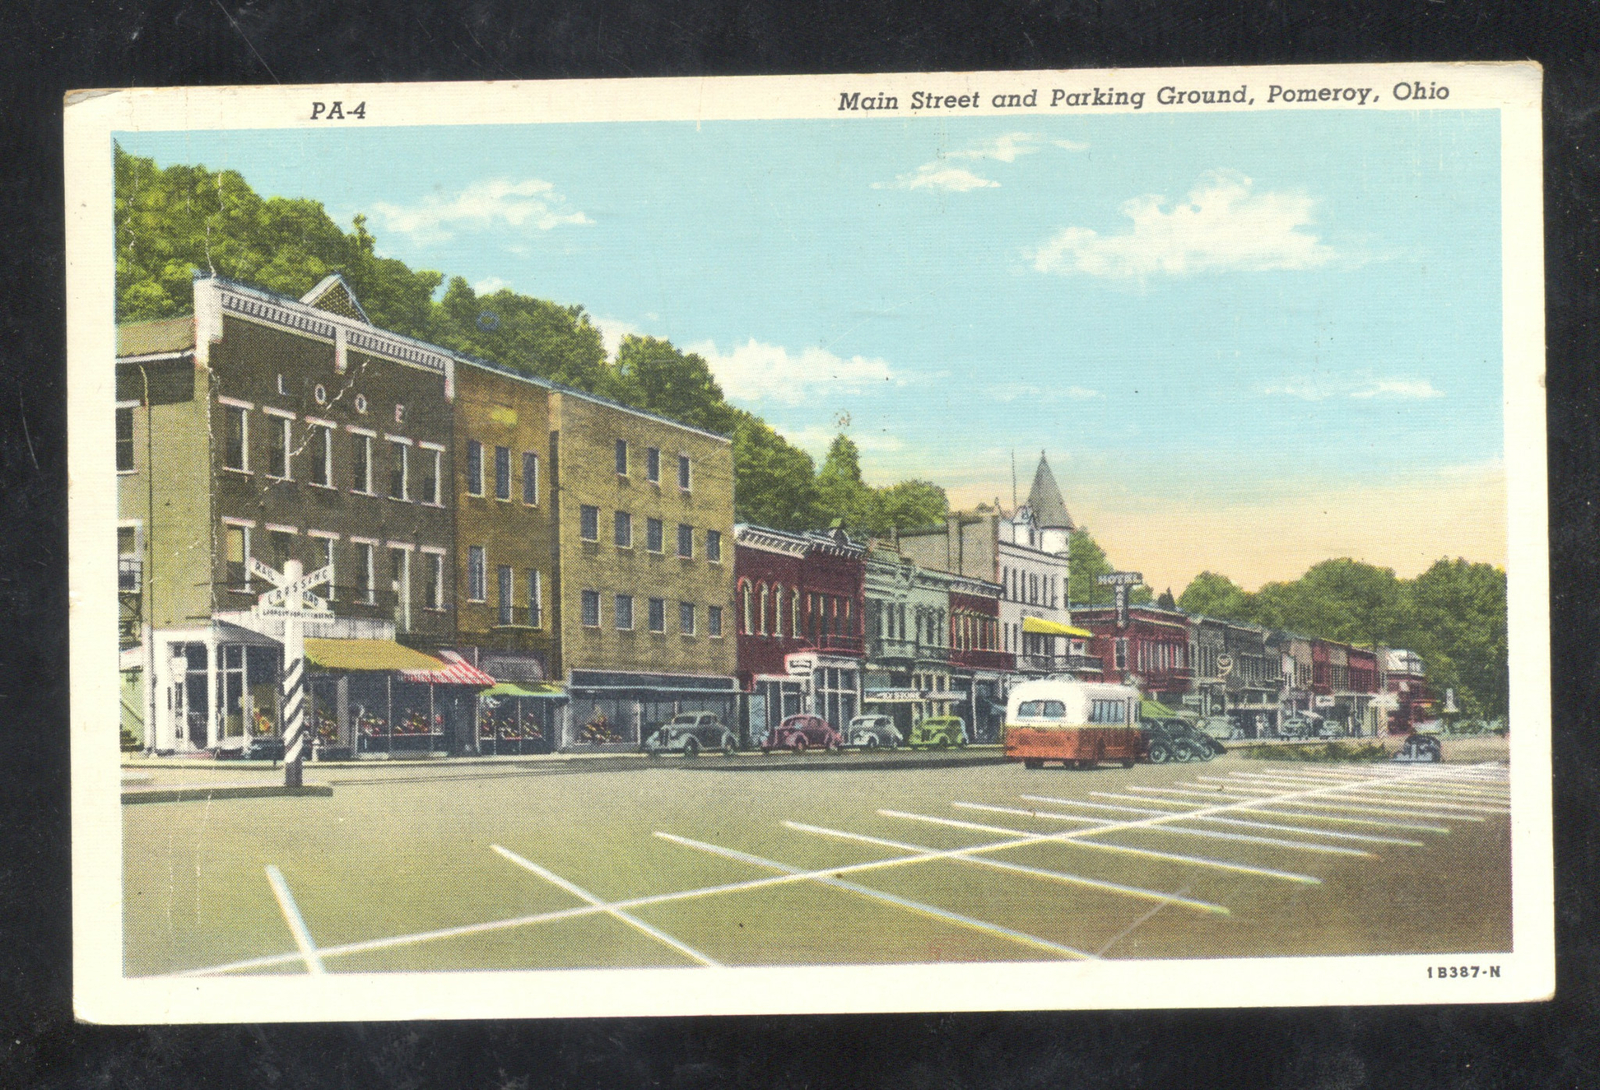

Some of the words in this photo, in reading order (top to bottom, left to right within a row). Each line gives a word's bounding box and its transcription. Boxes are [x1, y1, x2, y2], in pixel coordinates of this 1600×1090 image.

[838, 92, 899, 111] Main
[910, 91, 980, 110] Street
[991, 89, 1037, 108] and
[1049, 87, 1145, 110] Parking
[1156, 84, 1256, 106] Ground,
[1267, 84, 1380, 106] Pomeroy,
[1392, 81, 1450, 101] Ohio
[310, 101, 366, 120] PA-4
[1098, 574, 1141, 585] HOTEL
[1427, 965, 1501, 979] 1B387-N
